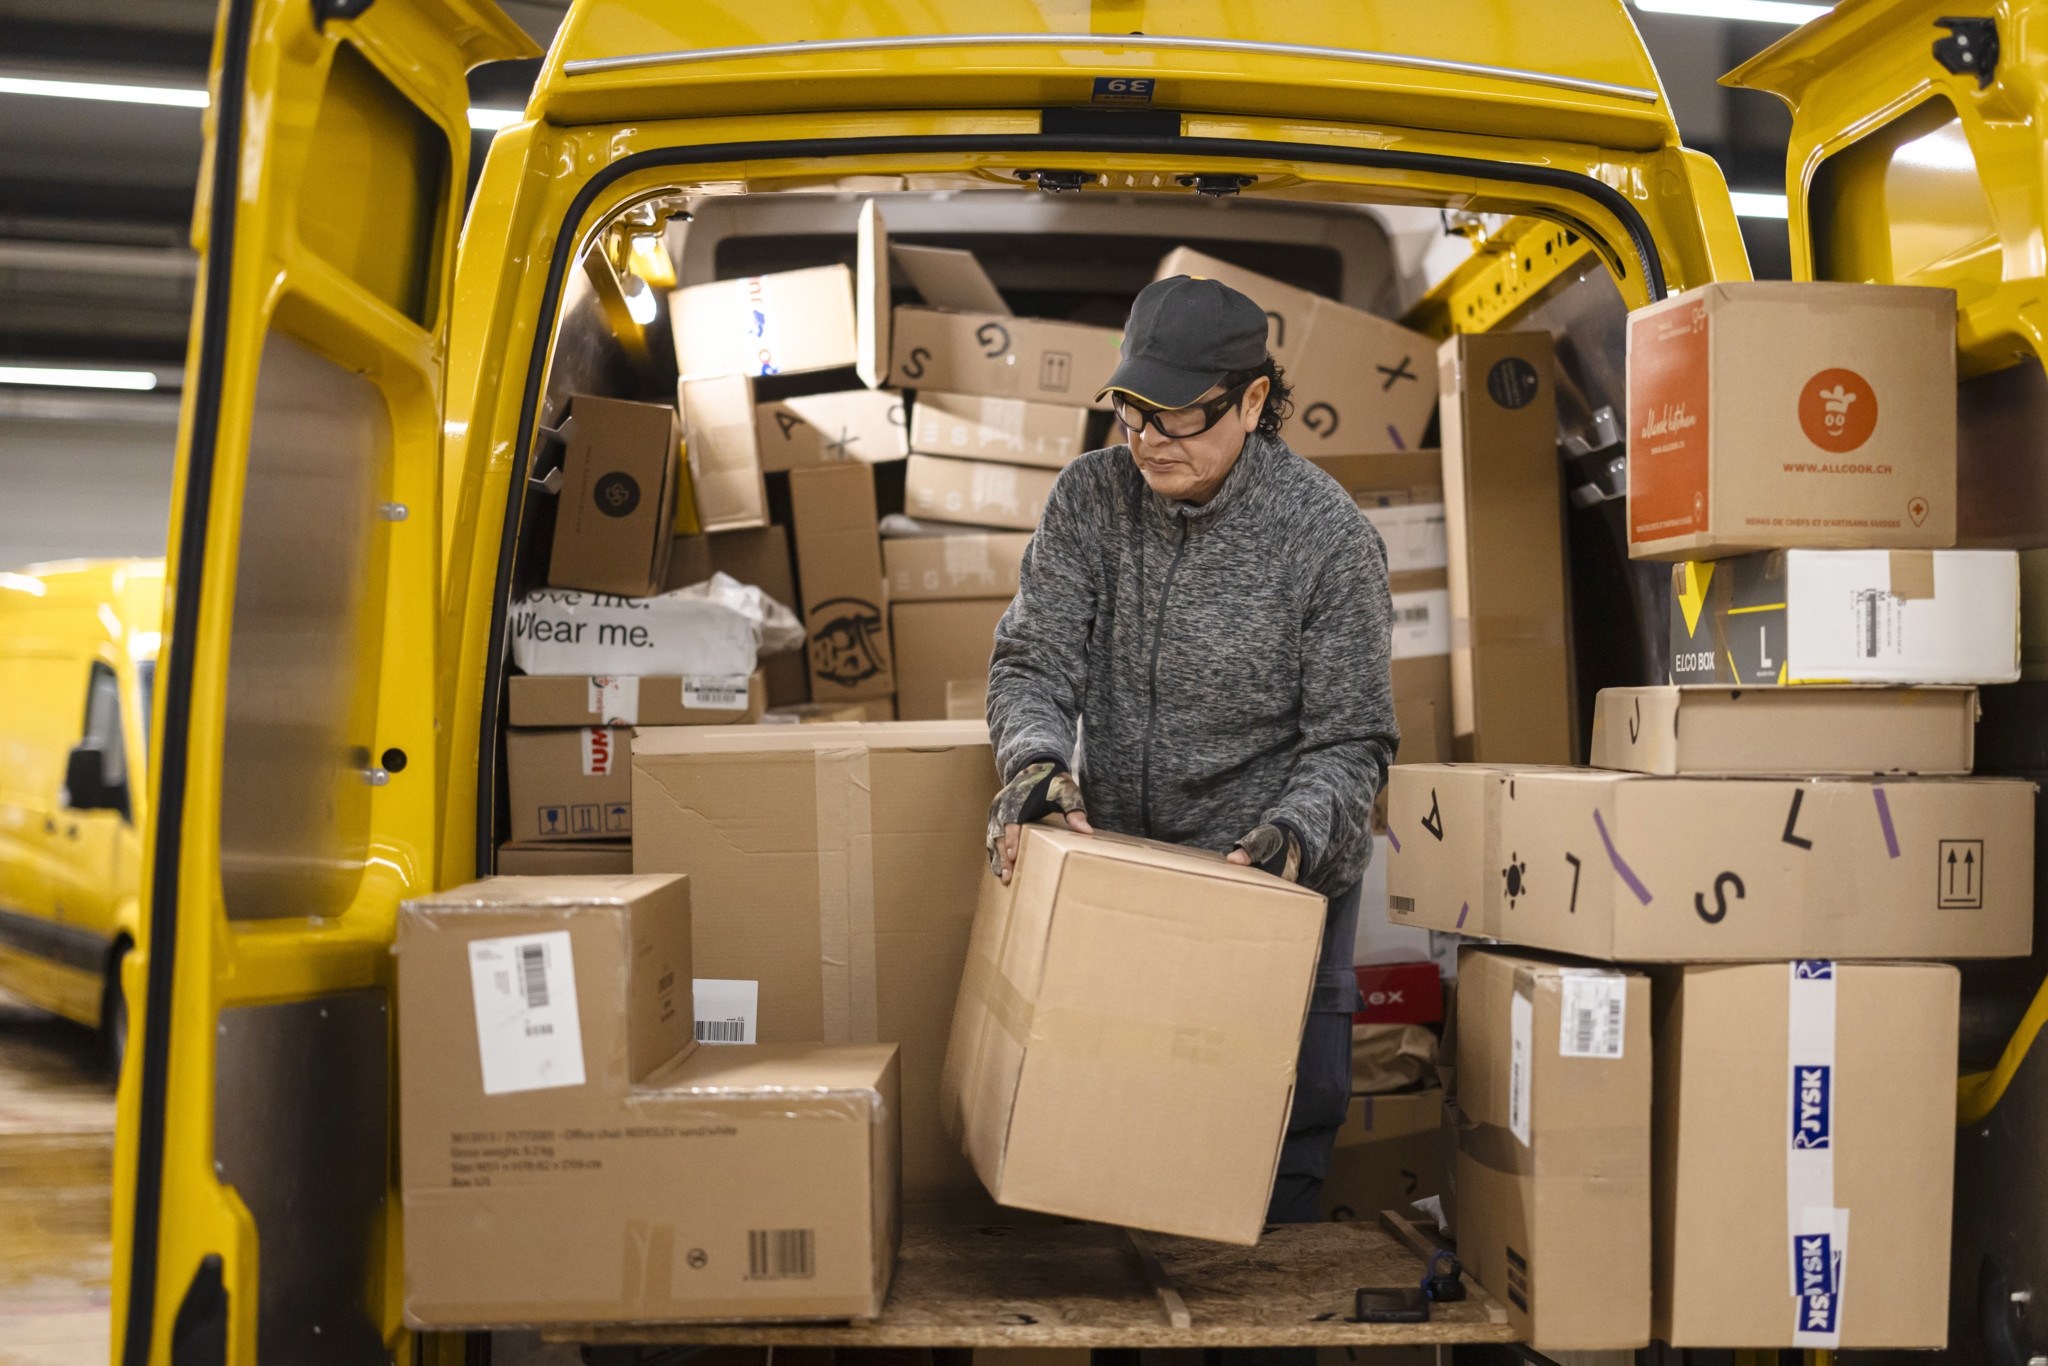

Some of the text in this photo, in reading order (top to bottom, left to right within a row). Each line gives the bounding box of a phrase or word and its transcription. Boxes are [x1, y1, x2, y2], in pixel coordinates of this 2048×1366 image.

[902, 348, 931, 379] S
[775, 411, 804, 440] A
[922, 422, 1070, 457] ESPRIT
[1782, 463, 1893, 474] WWW.ALLCOOK.CH
[1772, 518, 1783, 526] DE
[1812, 519, 1821, 527] ET
[599, 623, 654, 647] me.
[1760, 626, 1772, 668] L
[1675, 651, 1715, 673] ELCO BOX
[1421, 787, 1443, 841] A
[1781, 788, 1813, 850] L
[1695, 871, 1745, 924] S
[1801, 1069, 1822, 1133] JYSK
